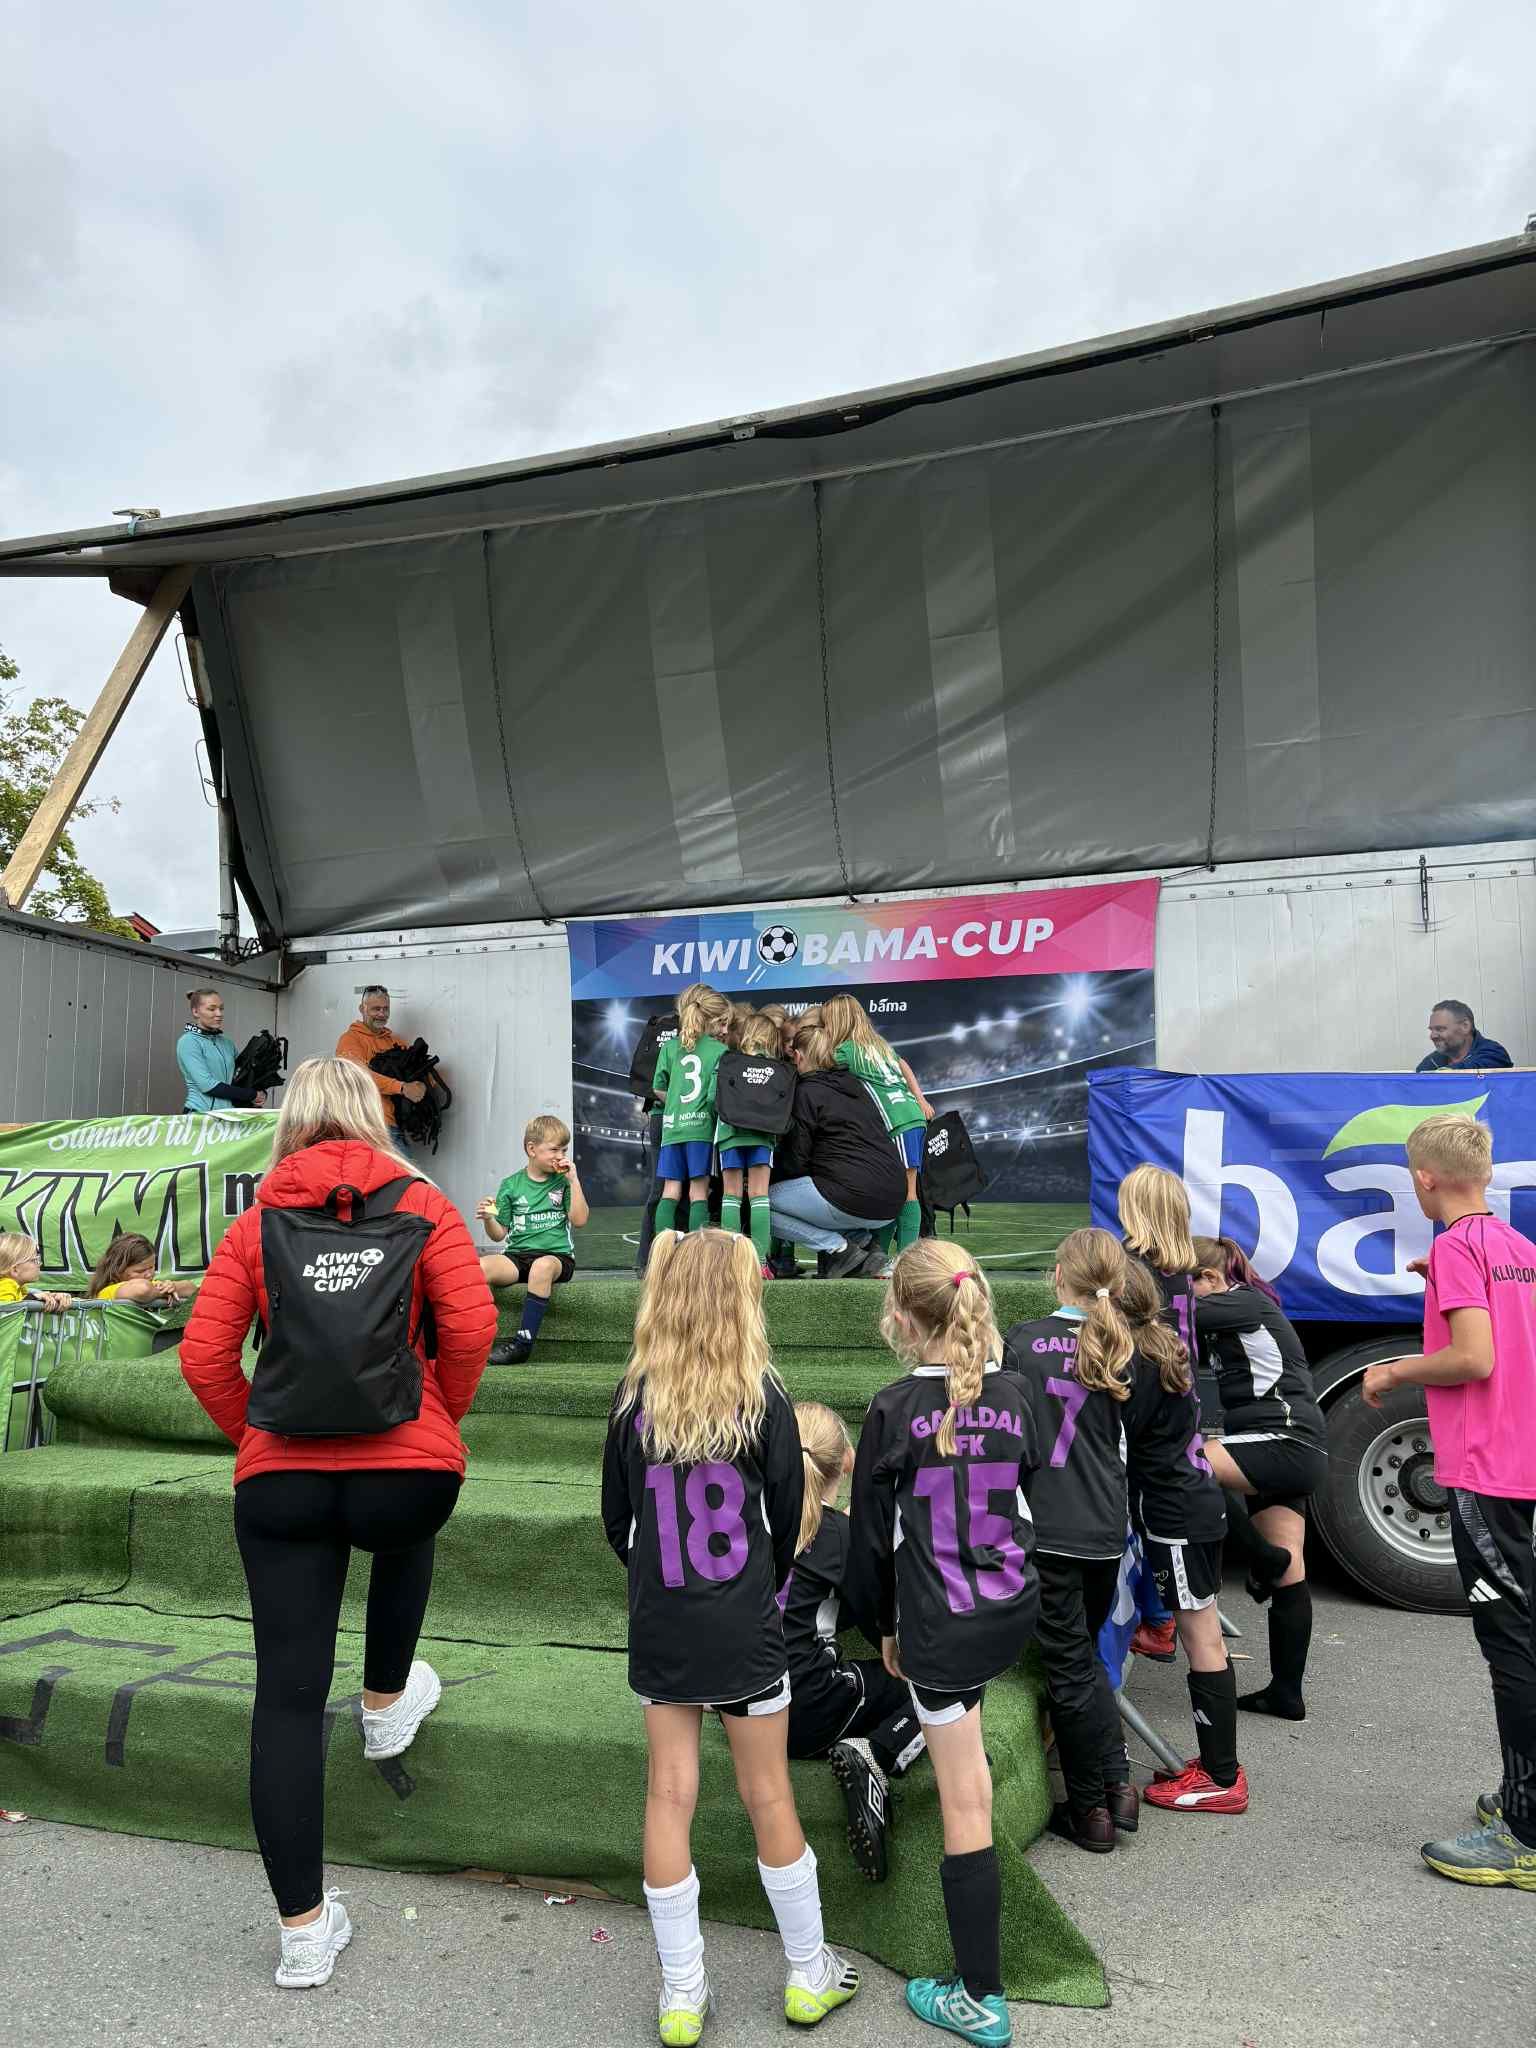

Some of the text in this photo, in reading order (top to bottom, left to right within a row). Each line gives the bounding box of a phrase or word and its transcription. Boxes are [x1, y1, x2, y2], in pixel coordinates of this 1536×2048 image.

[652, 917, 1055, 976] KIWI BAMA-CUP
[680, 1054, 702, 1103] 3
[302, 1264, 362, 1279] BAMA-
[316, 1252, 360, 1266] KIWI
[314, 1278, 354, 1292] CUP
[955, 1434, 986, 1456] FK
[1046, 1376, 1089, 1468] 7
[645, 1461, 749, 1588] 18
[913, 1462, 1026, 1613] 15
